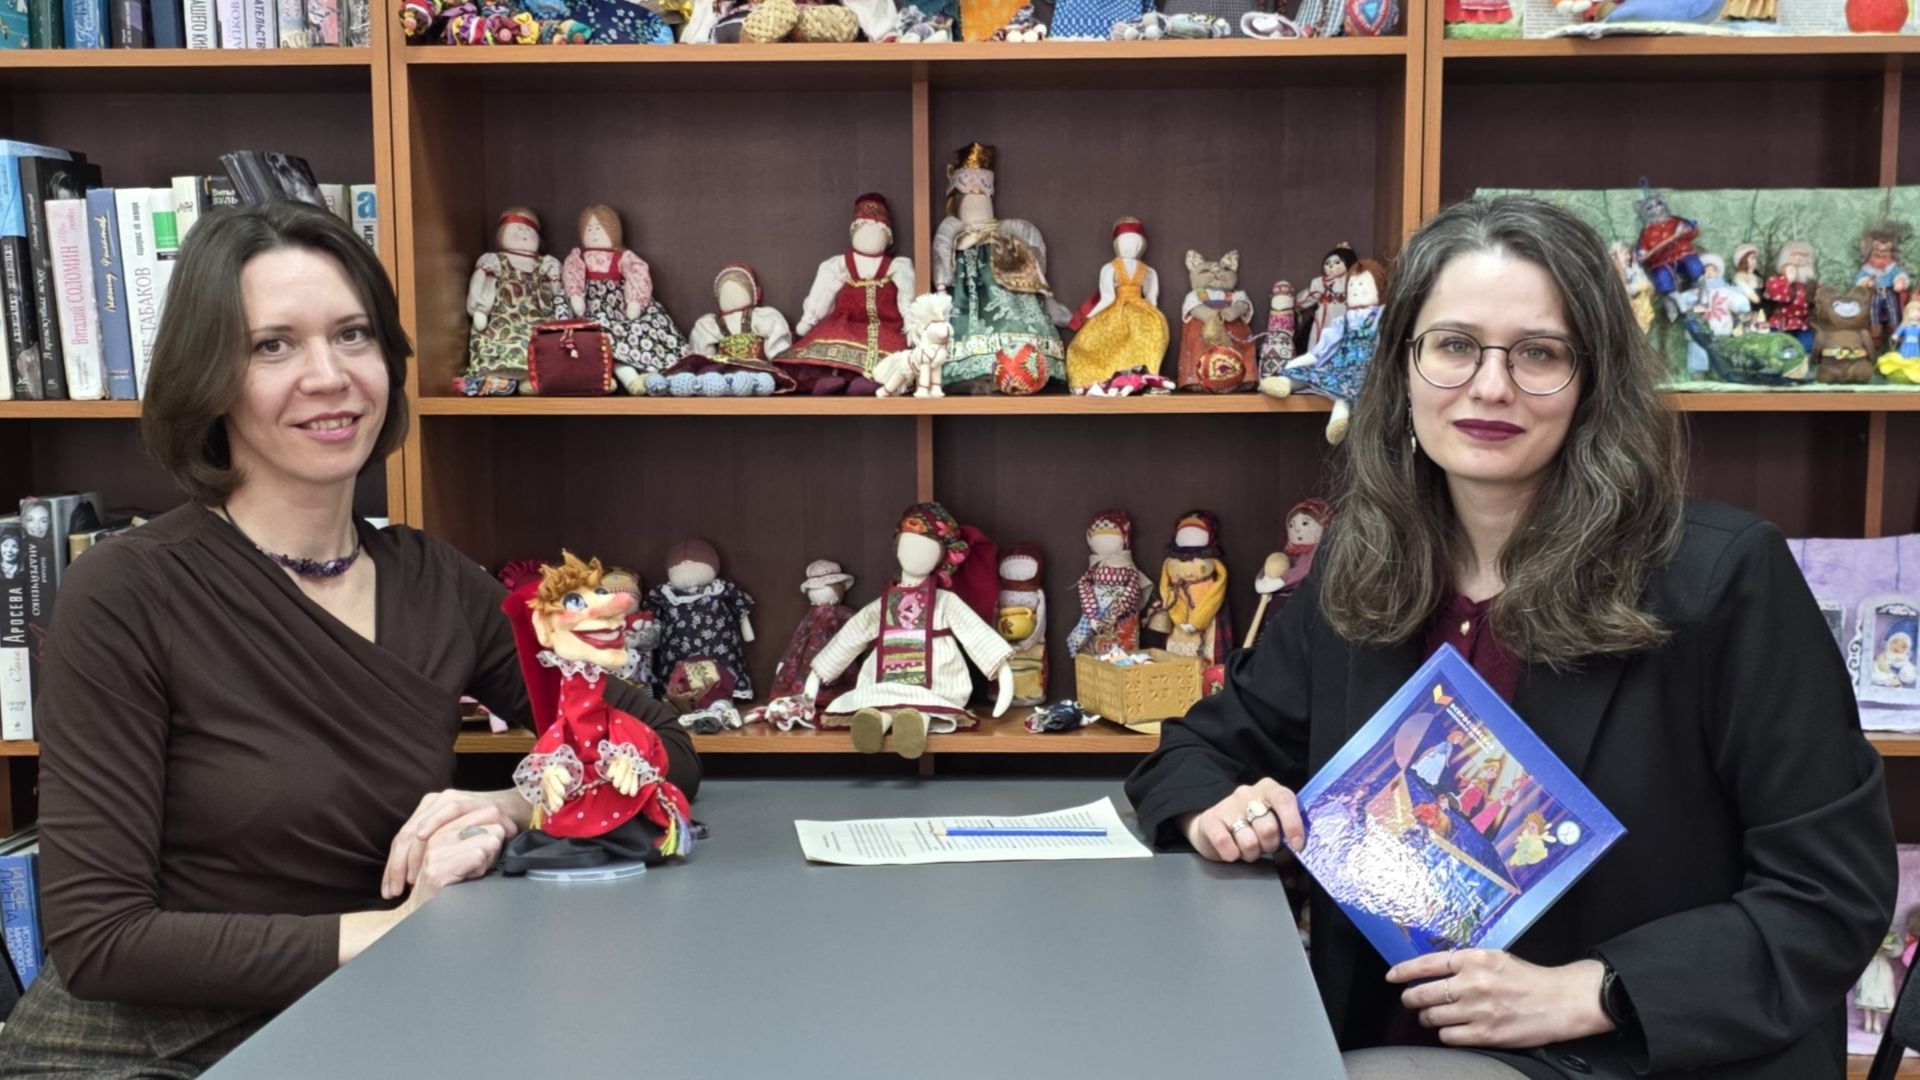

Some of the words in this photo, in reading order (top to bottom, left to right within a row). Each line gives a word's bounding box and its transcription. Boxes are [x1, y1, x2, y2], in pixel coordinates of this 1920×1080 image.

[61, 245, 84, 301] СОЛОМИН
[135, 267, 157, 335] ТАБАКОВ
[71, 303, 88, 345] Виталий
[2, 587, 26, 643] АРОСЕВА
